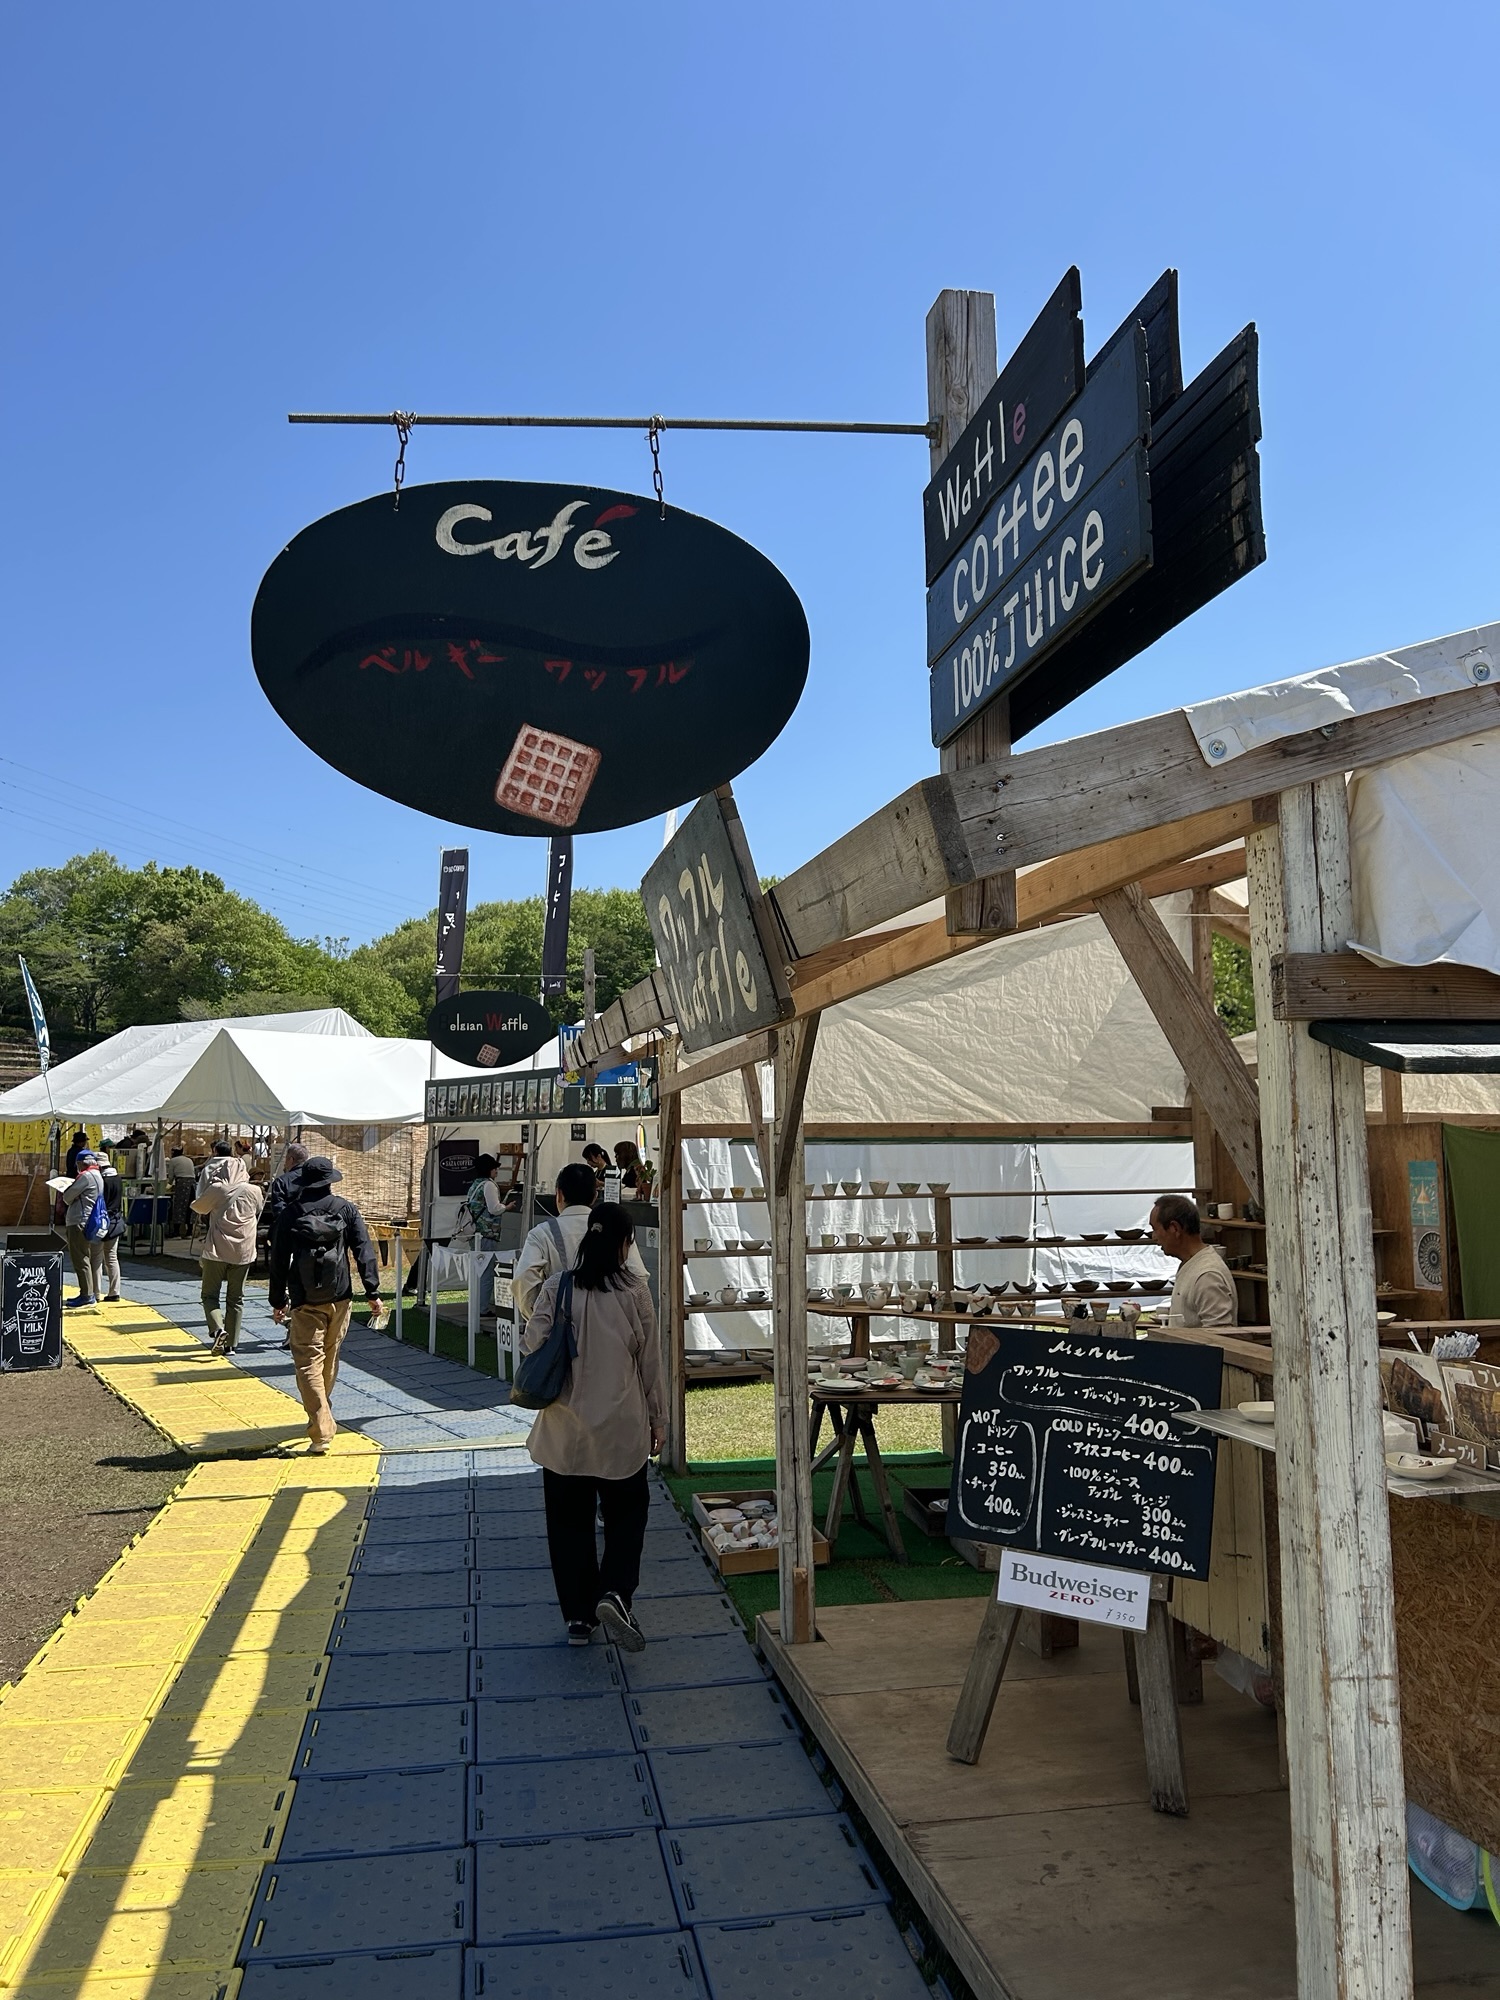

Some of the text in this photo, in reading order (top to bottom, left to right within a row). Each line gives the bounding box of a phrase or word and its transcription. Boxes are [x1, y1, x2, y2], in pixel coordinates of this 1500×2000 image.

[435, 500, 640, 570] Café
[953, 617, 1000, 717] 100%
[486, 1013, 529, 1031] Waffle
[23, 1322, 44, 1333] MILK
[498, 1324, 511, 1347] 166
[1013, 1365, 1060, 1378] ワッフル
[987, 1424, 1018, 1439] ドリンク
[1052, 1418, 1121, 1441] COLD ドリンク
[1087, 1485, 1170, 1508] アップル オレンジ
[1010, 1562, 1139, 1603] Budweiser
[1049, 1590, 1095, 1606] ZERO
